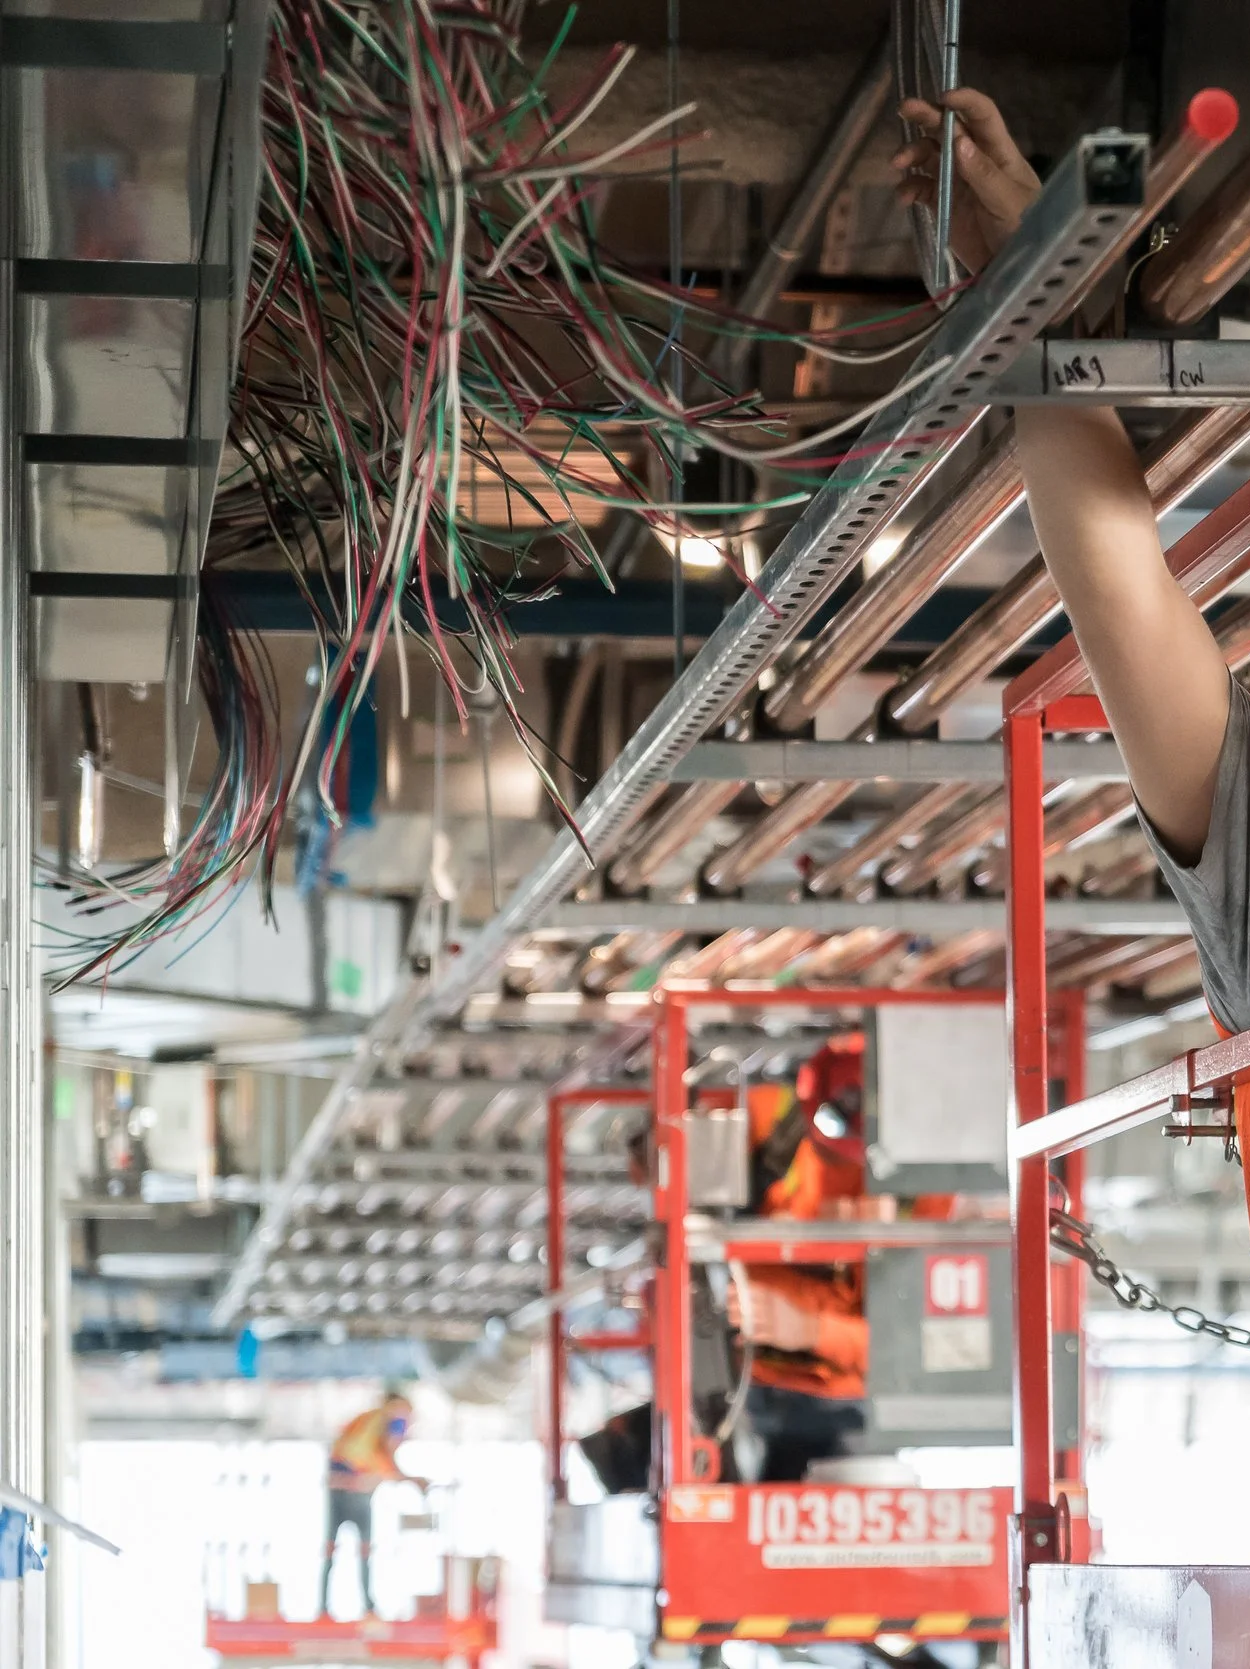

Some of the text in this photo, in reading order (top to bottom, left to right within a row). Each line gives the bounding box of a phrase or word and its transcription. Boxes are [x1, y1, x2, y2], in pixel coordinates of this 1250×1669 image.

[1180, 362, 1204, 388] CW
[930, 1260, 980, 1310] 01
[748, 1490, 995, 1545] 10395396
